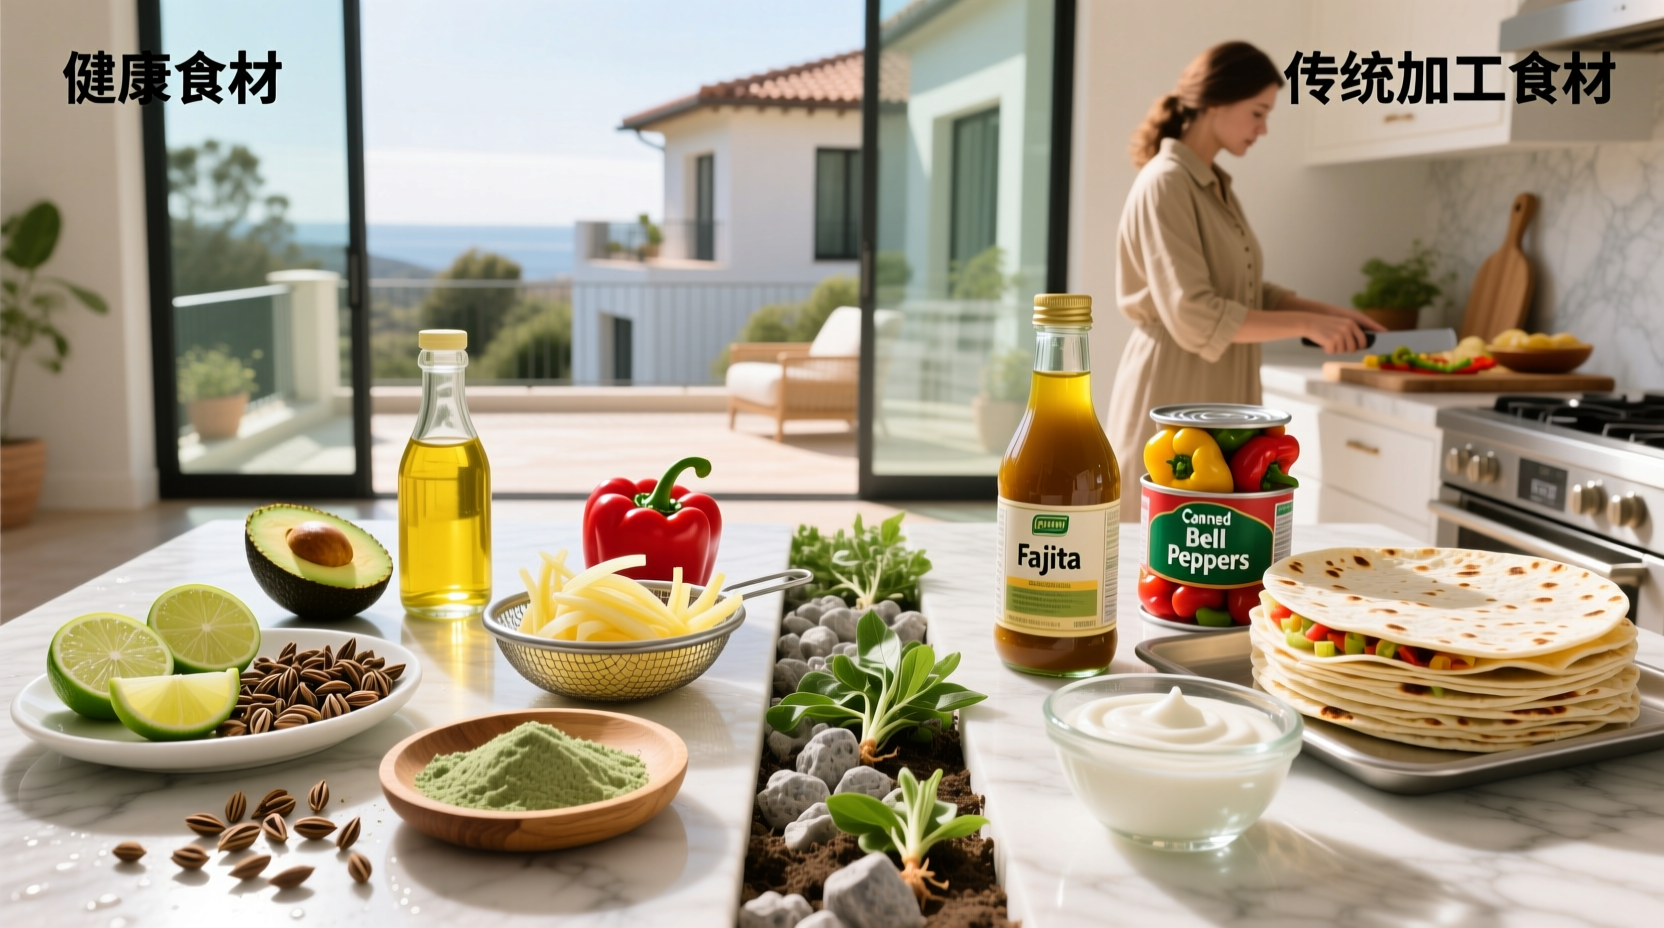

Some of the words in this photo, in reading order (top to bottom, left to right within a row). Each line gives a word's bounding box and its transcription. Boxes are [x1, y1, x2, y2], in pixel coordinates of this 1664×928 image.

[1182, 508, 1231, 525] Canned
[1186, 527, 1226, 549] Bell
[1018, 543, 1081, 576] Fajita
[1168, 544, 1250, 576] Peppers
